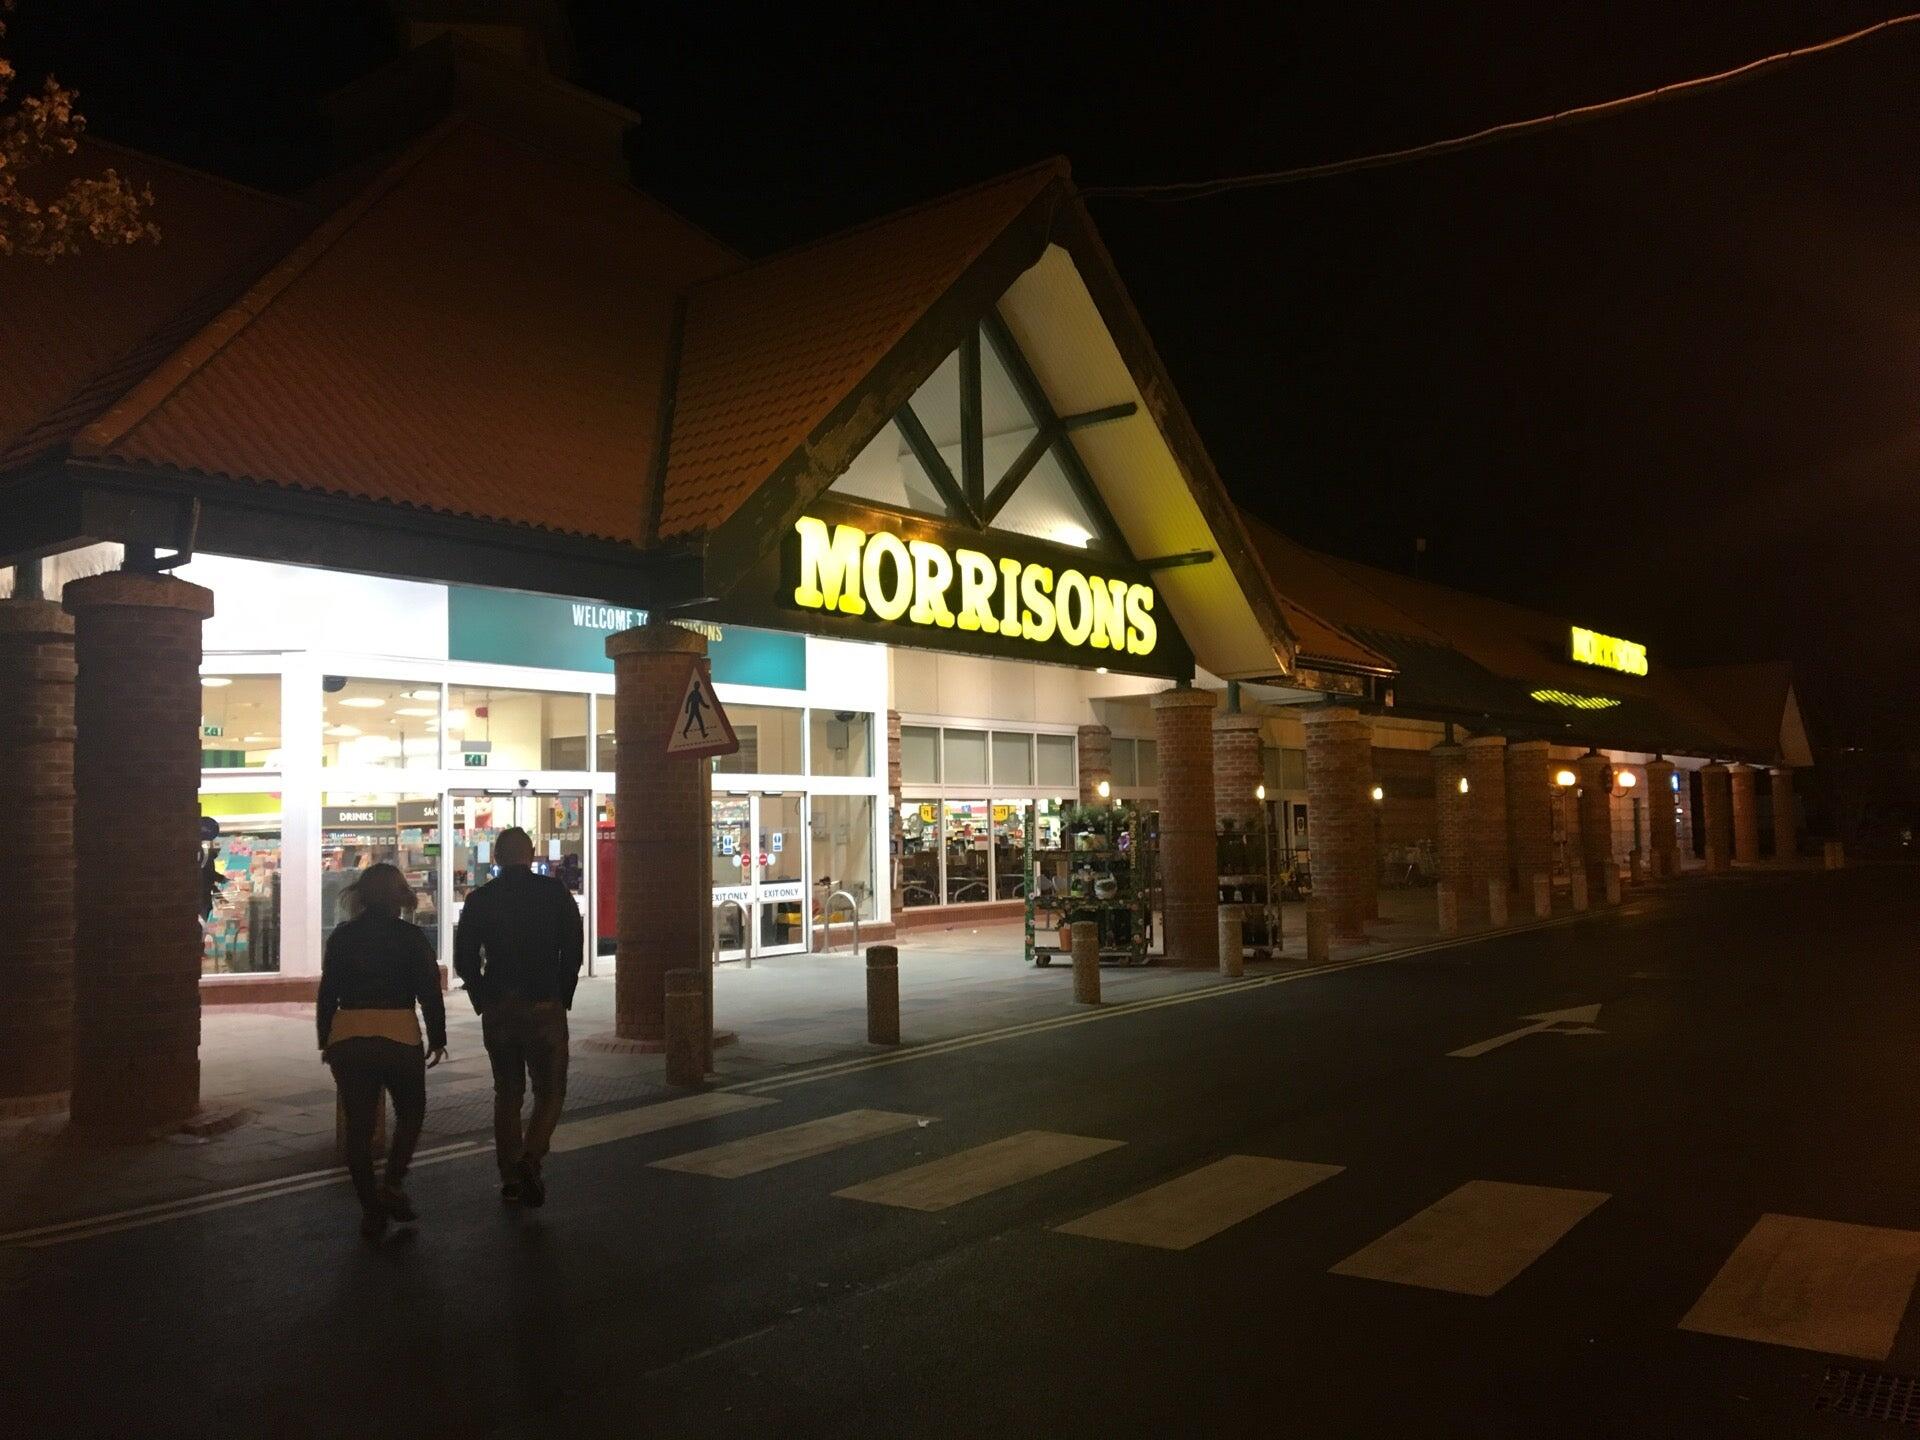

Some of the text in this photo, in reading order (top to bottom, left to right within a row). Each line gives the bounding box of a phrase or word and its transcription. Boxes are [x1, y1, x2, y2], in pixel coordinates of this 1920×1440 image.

[795, 516, 1158, 656] MORRISONS
[339, 812, 374, 822] DRINKS
[727, 891, 748, 900] ONLY
[764, 888, 799, 898] EXIT ONLY
